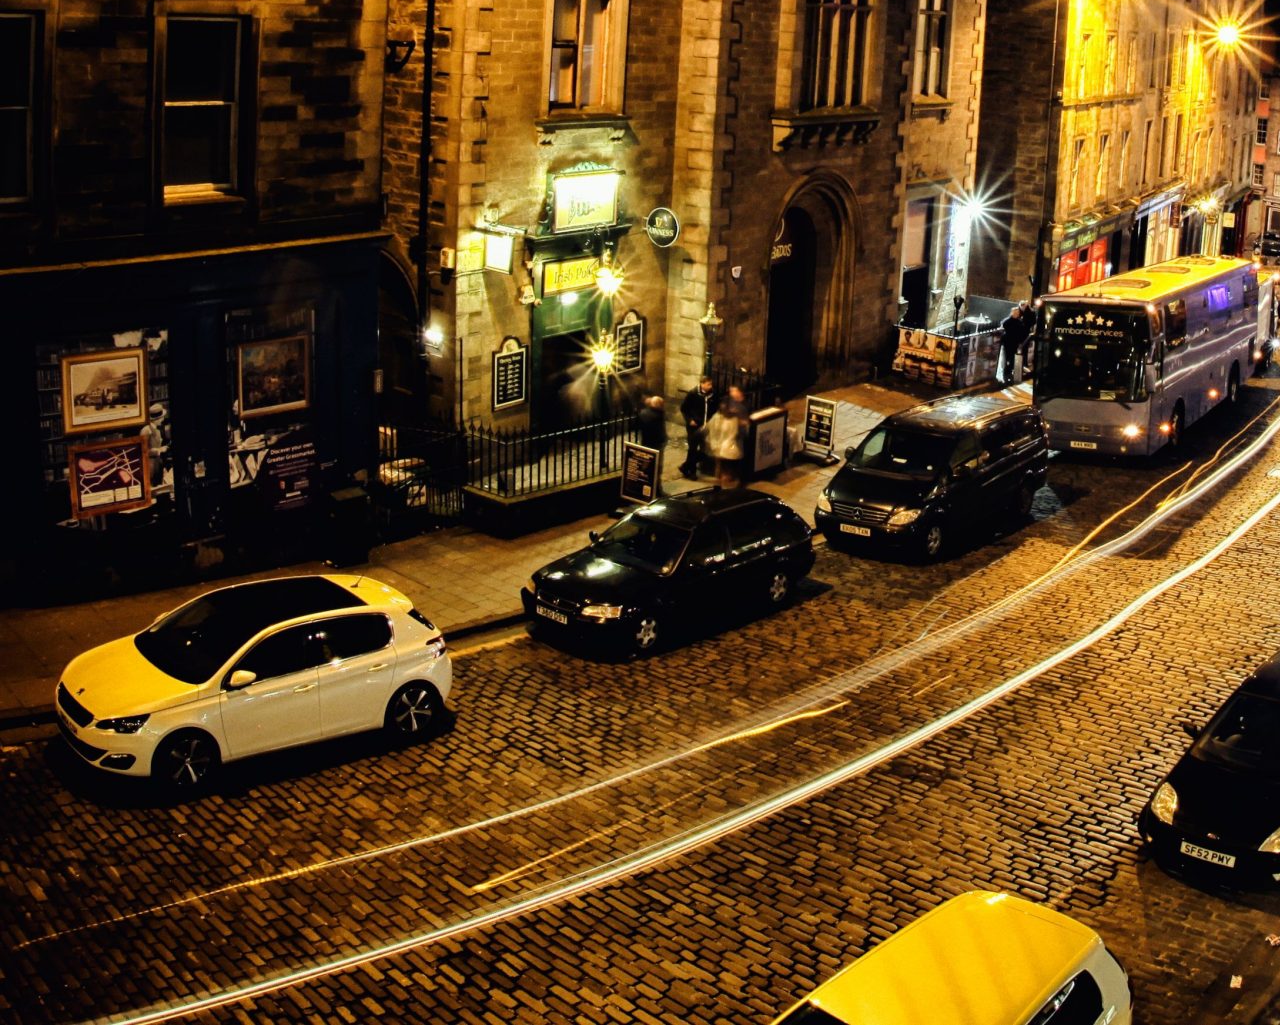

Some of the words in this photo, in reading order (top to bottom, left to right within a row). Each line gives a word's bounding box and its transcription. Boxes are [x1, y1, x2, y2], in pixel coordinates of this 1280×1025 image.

[554, 270, 573, 284] Irish
[270, 447, 291, 455] Discover
[267, 455, 285, 464] Greater
[1184, 844, 1209, 860] SF52
[1211, 852, 1231, 865] PMY
